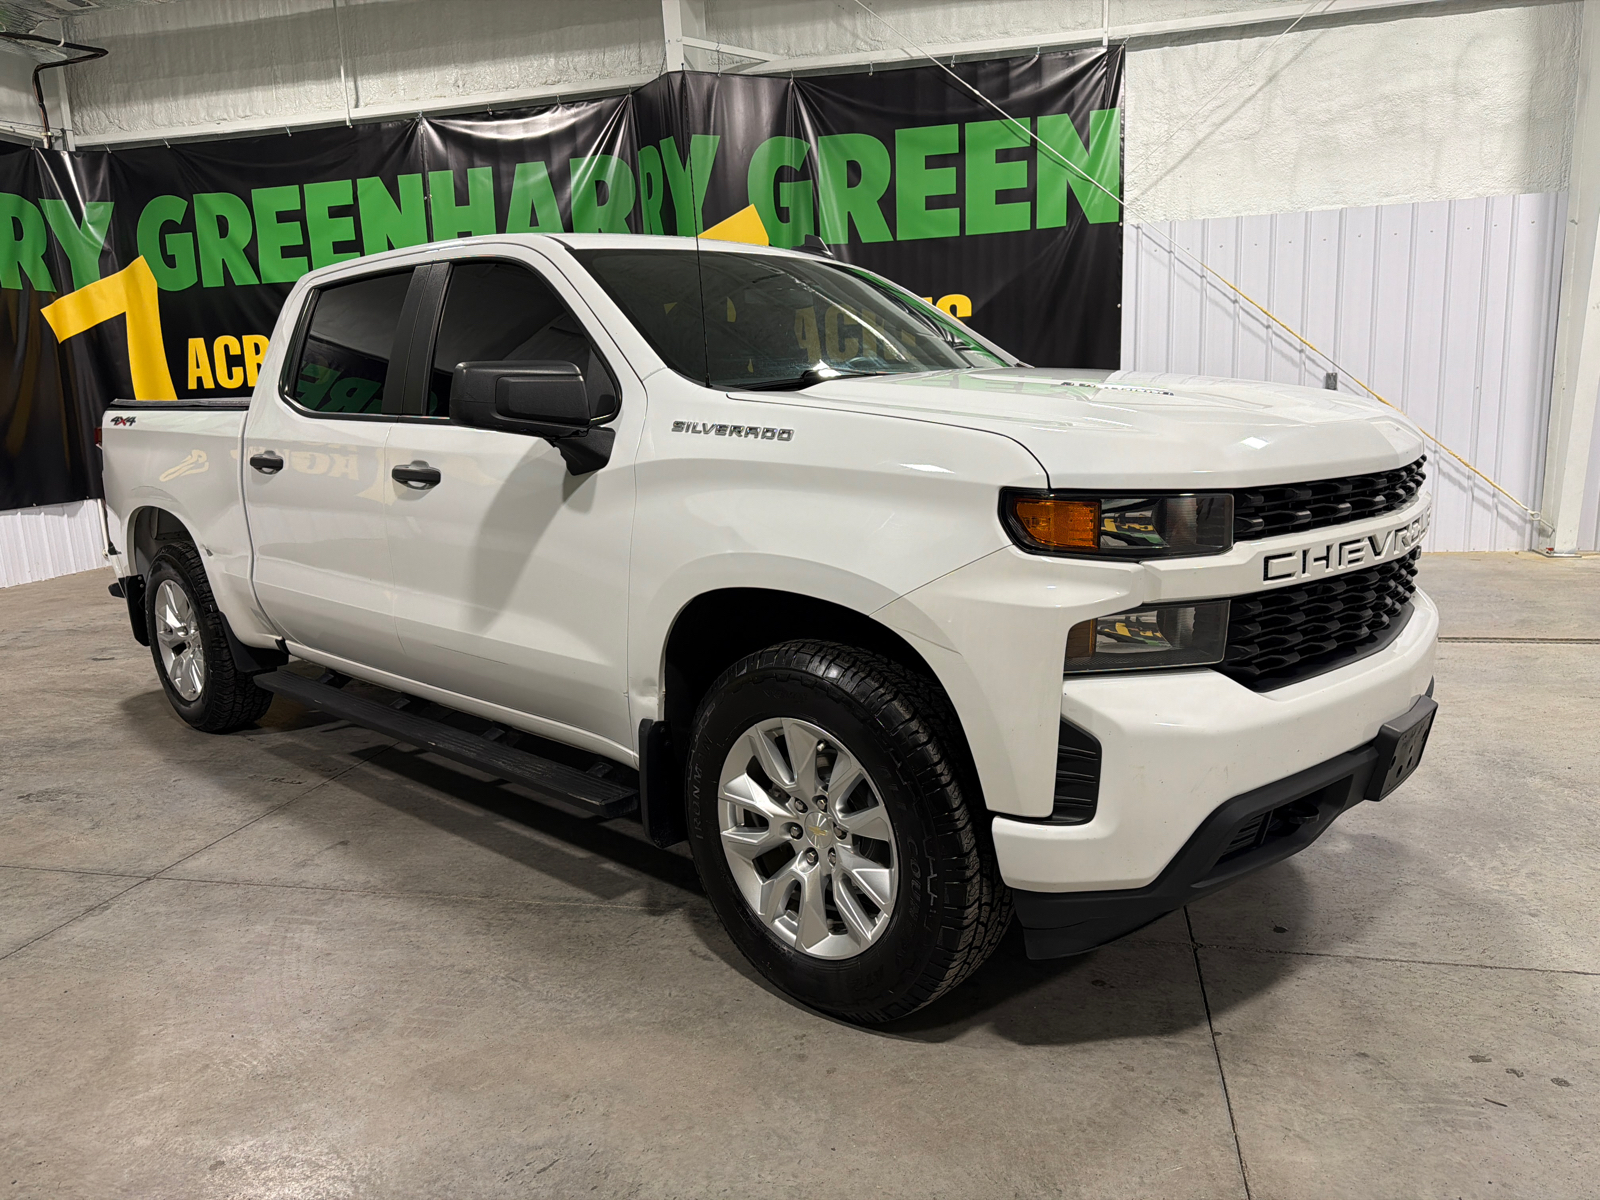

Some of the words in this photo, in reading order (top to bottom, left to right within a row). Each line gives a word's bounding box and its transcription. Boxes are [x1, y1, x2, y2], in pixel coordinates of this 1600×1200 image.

[136, 174, 426, 292] GREEN
[428, 133, 720, 238] HARRY
[748, 107, 1120, 250] GREEN
[41, 254, 178, 401] 7
[671, 420, 795, 442] SILVERADO
